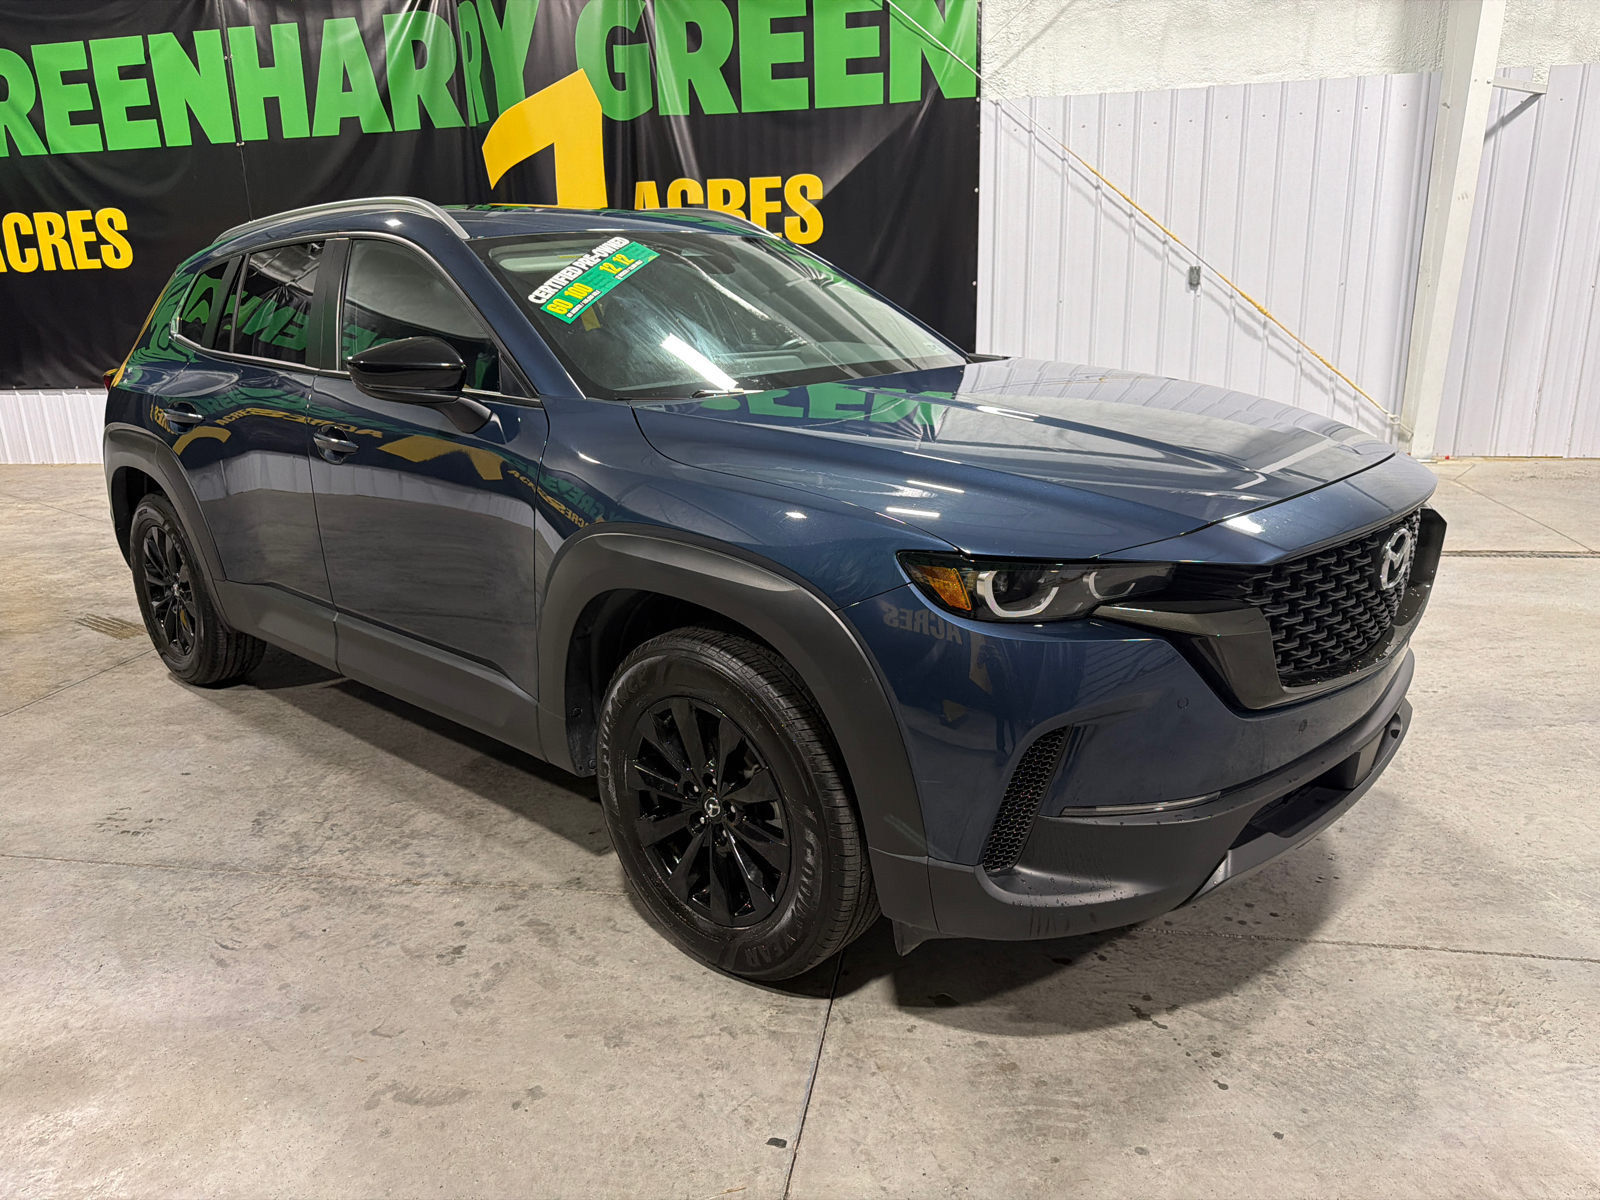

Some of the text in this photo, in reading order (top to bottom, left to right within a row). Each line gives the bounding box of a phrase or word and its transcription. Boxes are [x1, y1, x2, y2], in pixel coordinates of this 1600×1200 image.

[575, 0, 977, 121] GREEN
[0, 207, 134, 273] CRES
[527, 264, 583, 304] CERTIFIED
[572, 236, 630, 271] PRE-OWNED
[599, 262, 622, 275] 12
[612, 253, 635, 266] 12
[546, 298, 574, 315] 60
[564, 282, 594, 300] 100
